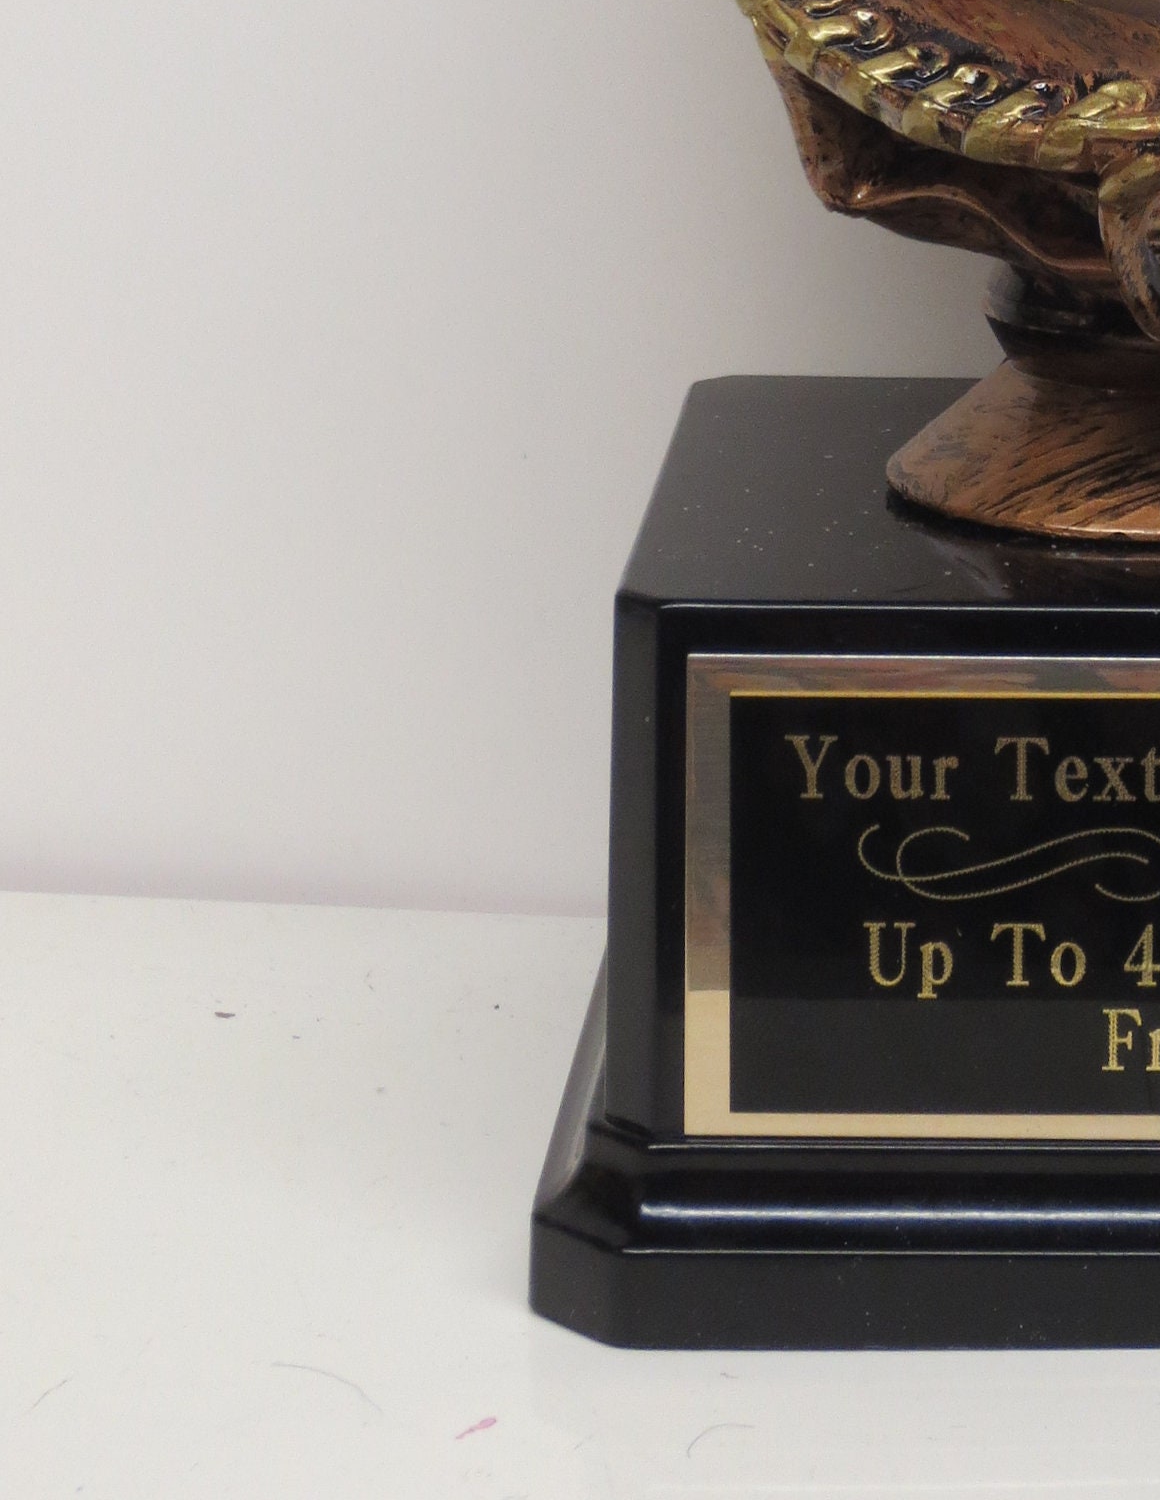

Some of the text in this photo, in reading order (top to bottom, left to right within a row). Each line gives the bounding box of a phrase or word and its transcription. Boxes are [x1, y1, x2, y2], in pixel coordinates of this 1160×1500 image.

[785, 734, 958, 801] Your
[863, 922, 953, 999] Up
[991, 923, 1087, 987] To
